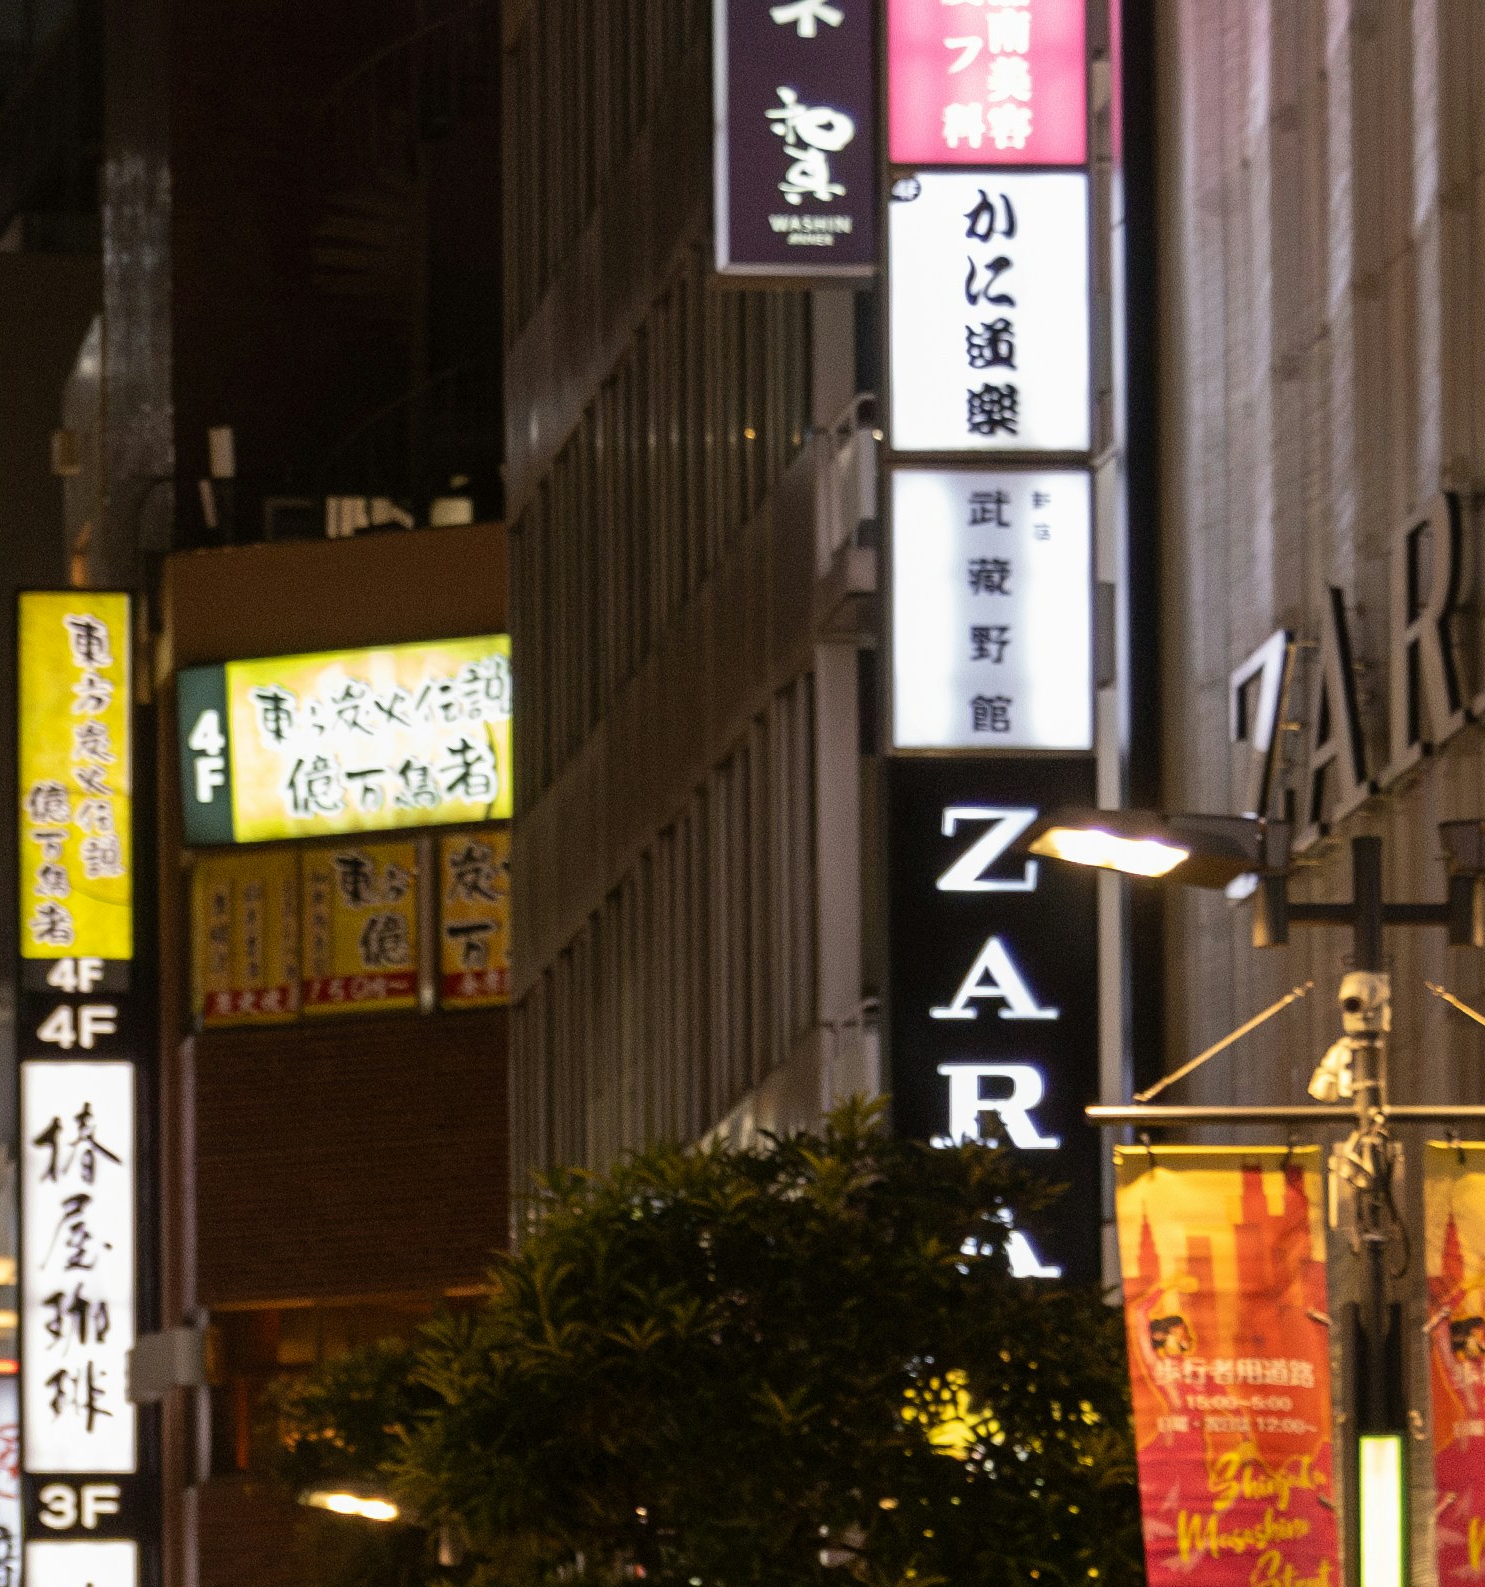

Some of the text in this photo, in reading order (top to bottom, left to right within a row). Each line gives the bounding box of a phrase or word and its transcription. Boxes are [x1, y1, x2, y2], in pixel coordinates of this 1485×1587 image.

[46, 957, 106, 993] 4F
[37, 1003, 118, 1050] 4F
[32, 1100, 123, 1434] 椿屋珈琲
[38, 1482, 122, 1530] 3F
